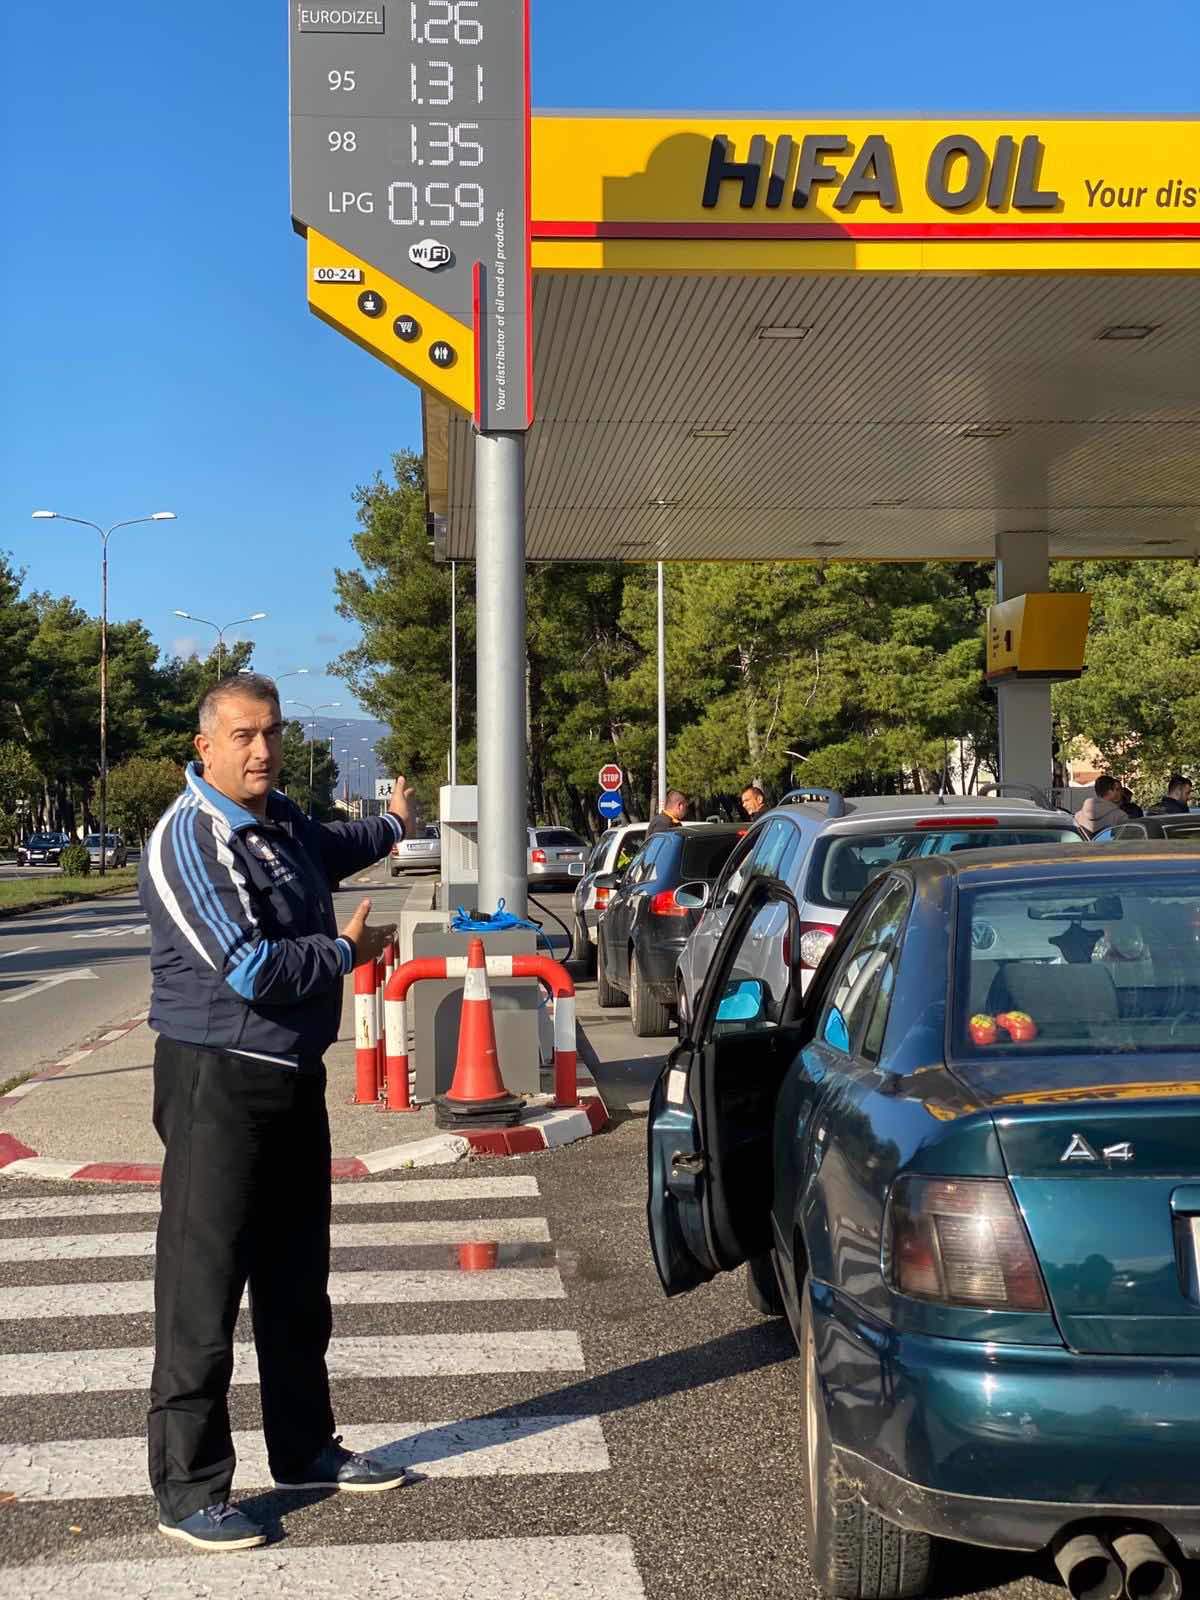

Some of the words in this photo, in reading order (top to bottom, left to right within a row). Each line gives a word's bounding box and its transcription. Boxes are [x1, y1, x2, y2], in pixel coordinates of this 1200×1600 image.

[301, 10, 383, 25] EURODIZEL
[411, 0, 483, 45] 1.26
[328, 70, 356, 91] 95
[411, 60, 484, 105] 1.31
[328, 131, 357, 151] 98
[411, 122, 484, 166] 1.35
[702, 134, 898, 209] HIFA
[925, 134, 1062, 209] OIL
[328, 192, 375, 213] LPG
[388, 181, 484, 226] 0.59
[1084, 179, 1148, 208] Your
[1155, 179, 1200, 208] dis
[495, 208, 507, 260] products.
[318, 269, 357, 280] 00-24
[495, 261, 505, 274] oil
[495, 277, 505, 297] and
[495, 299, 505, 312] oil
[495, 314, 505, 326] of
[495, 328, 505, 386] distributor
[495, 388, 506, 412] Your
[602, 773, 619, 783] STOP
[1059, 1133, 1136, 1162] A4
